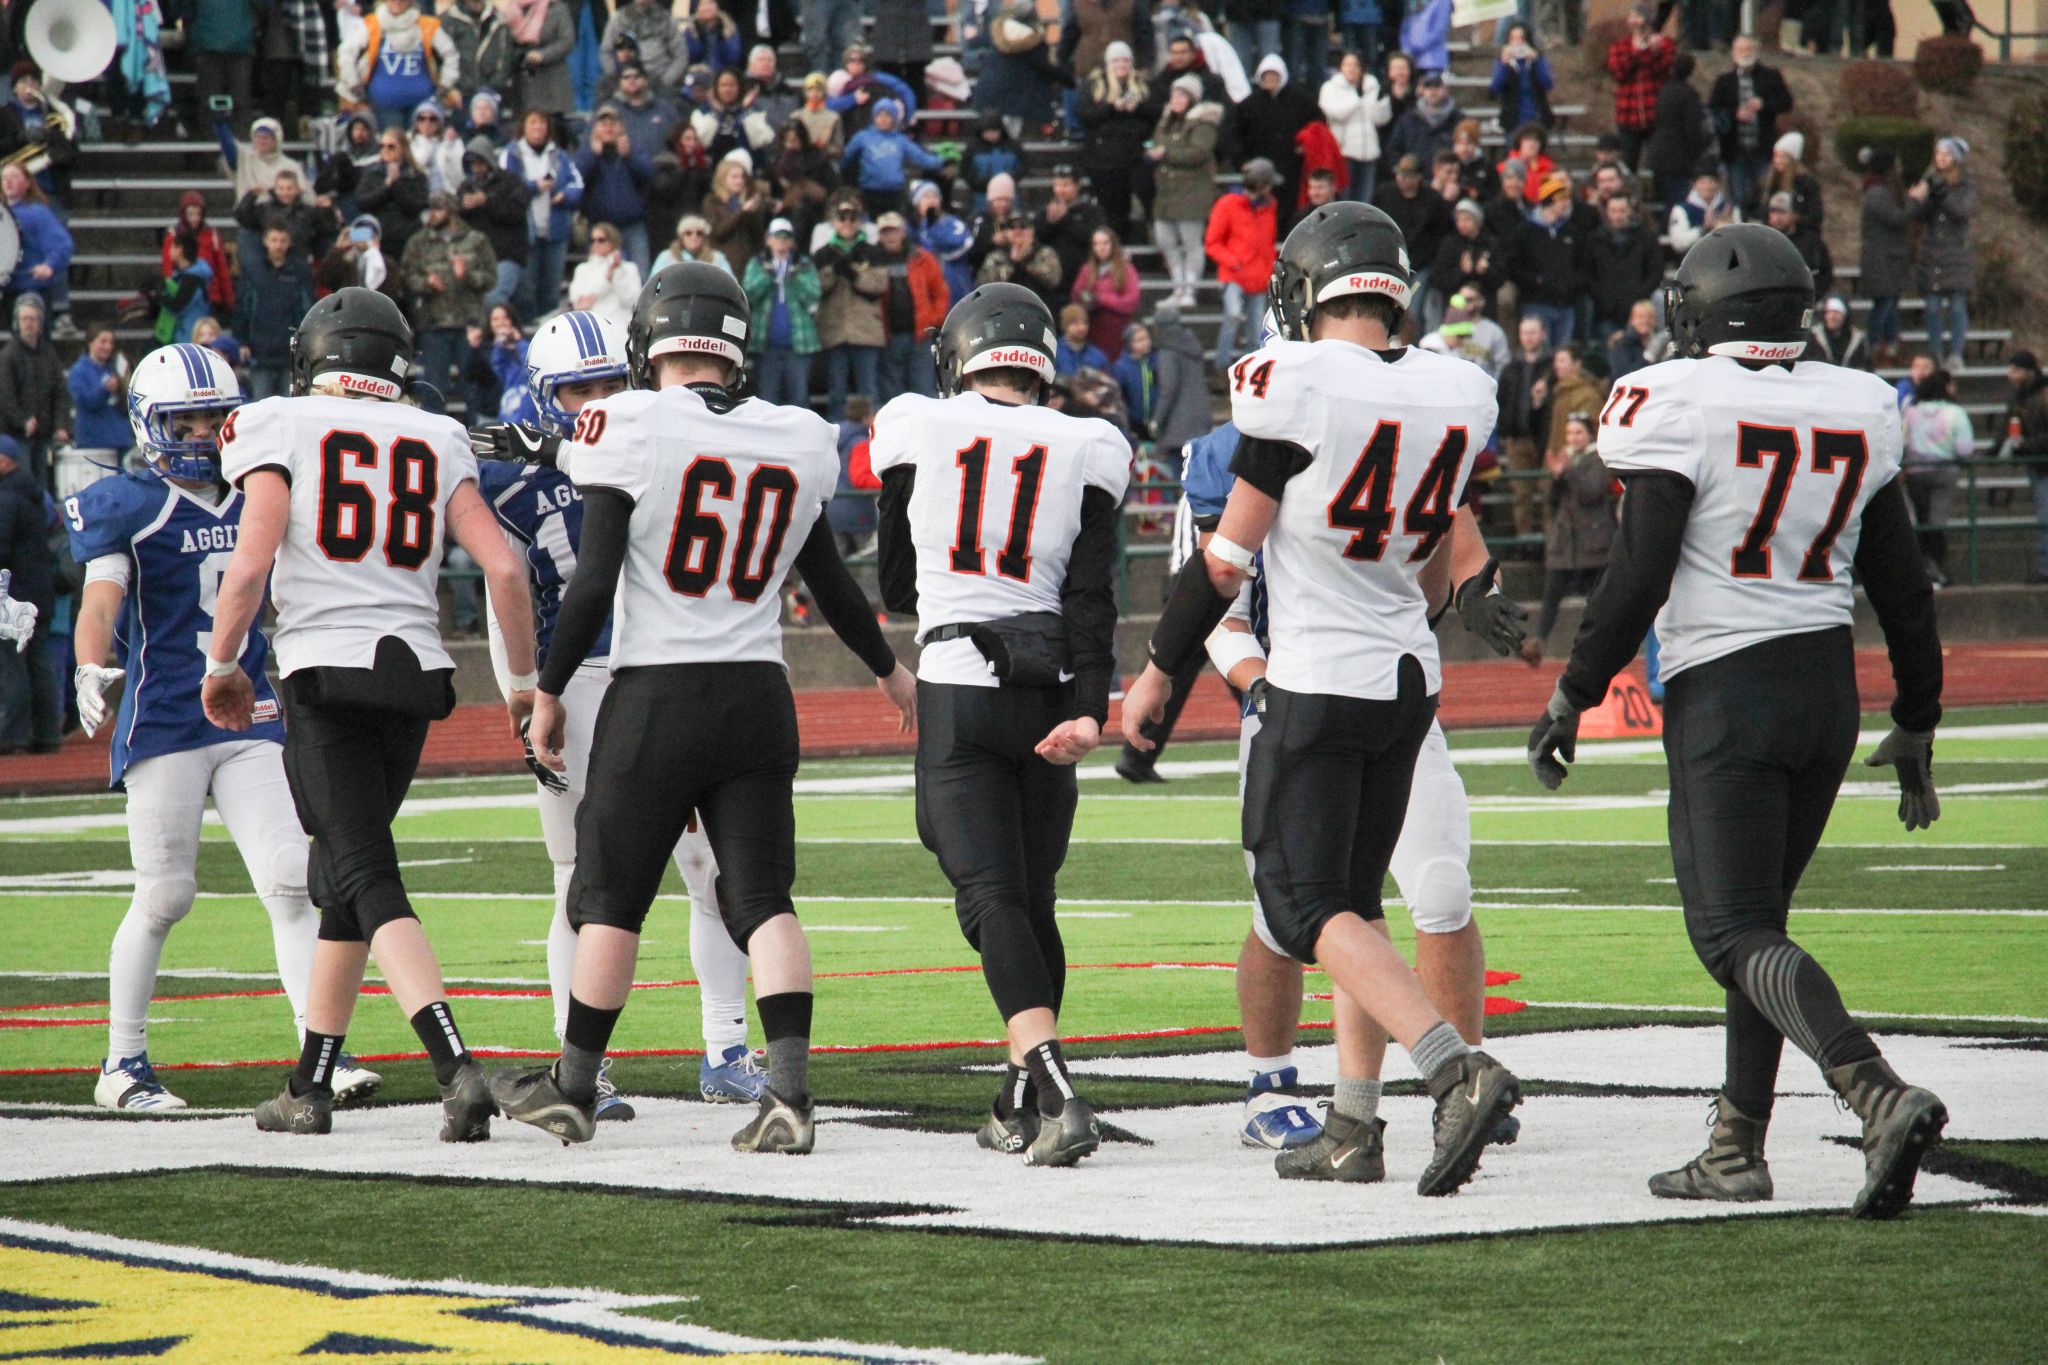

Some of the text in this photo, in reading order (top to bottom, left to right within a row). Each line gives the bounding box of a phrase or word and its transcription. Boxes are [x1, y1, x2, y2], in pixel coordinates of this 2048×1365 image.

[380, 54, 422, 76] VE
[1349, 277, 1405, 295] Riddell
[584, 356, 608, 367] Riddell
[678, 337, 727, 352] Riddell
[991, 350, 1046, 368] Riddell
[193, 390, 216, 398] Riddell
[339, 374, 394, 396] Riddell
[1234, 356, 1276, 400] 44
[1601, 386, 1649, 428] 77
[215, 410, 240, 451] 8
[574, 408, 608, 446] 60
[316, 429, 438, 571] 68
[949, 436, 1047, 583] 11
[1326, 418, 1467, 563] 44
[1731, 421, 1869, 581] 77
[65, 497, 84, 532] 9
[662, 455, 799, 604] 60
[181, 525, 240, 553] AGGI
[1613, 686, 1651, 728] 20
